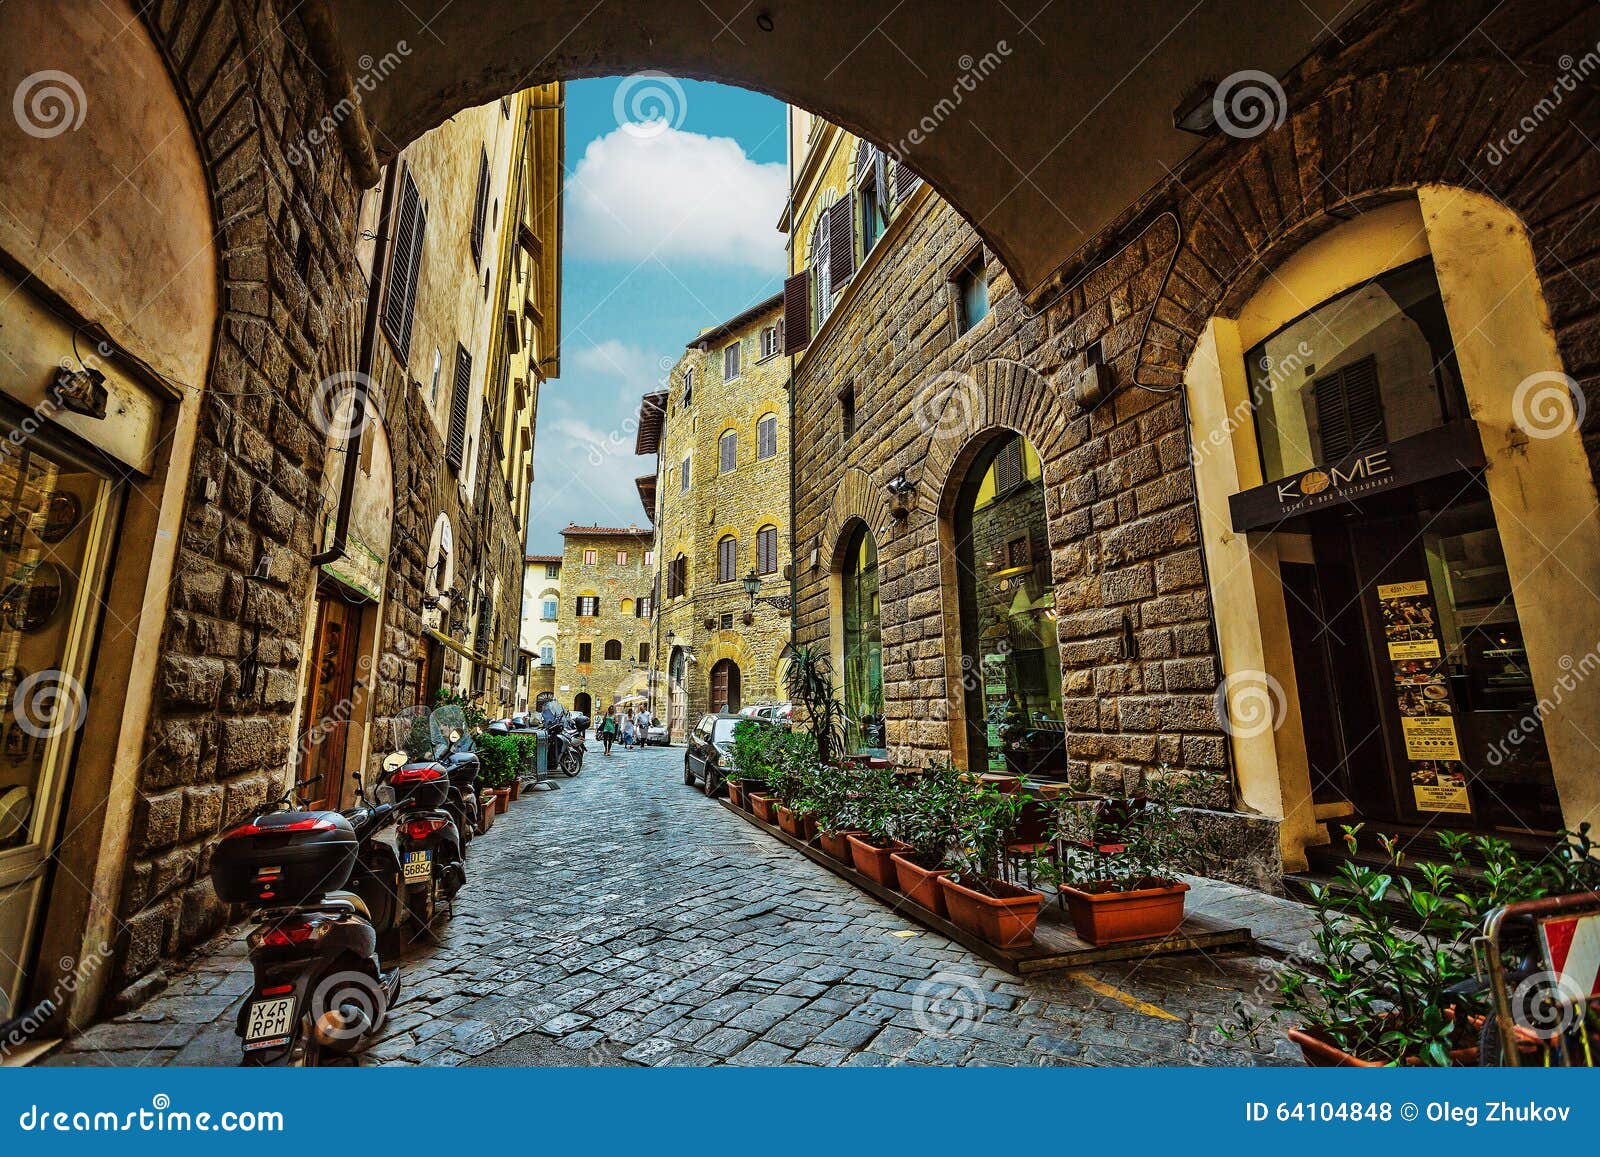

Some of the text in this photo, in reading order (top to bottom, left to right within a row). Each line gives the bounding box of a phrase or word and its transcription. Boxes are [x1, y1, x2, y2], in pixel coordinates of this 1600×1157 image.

[1339, 476, 1395, 497] RESTAURANT
[255, 1001, 288, 1020] X4R
[252, 1017, 286, 1037] RPM
